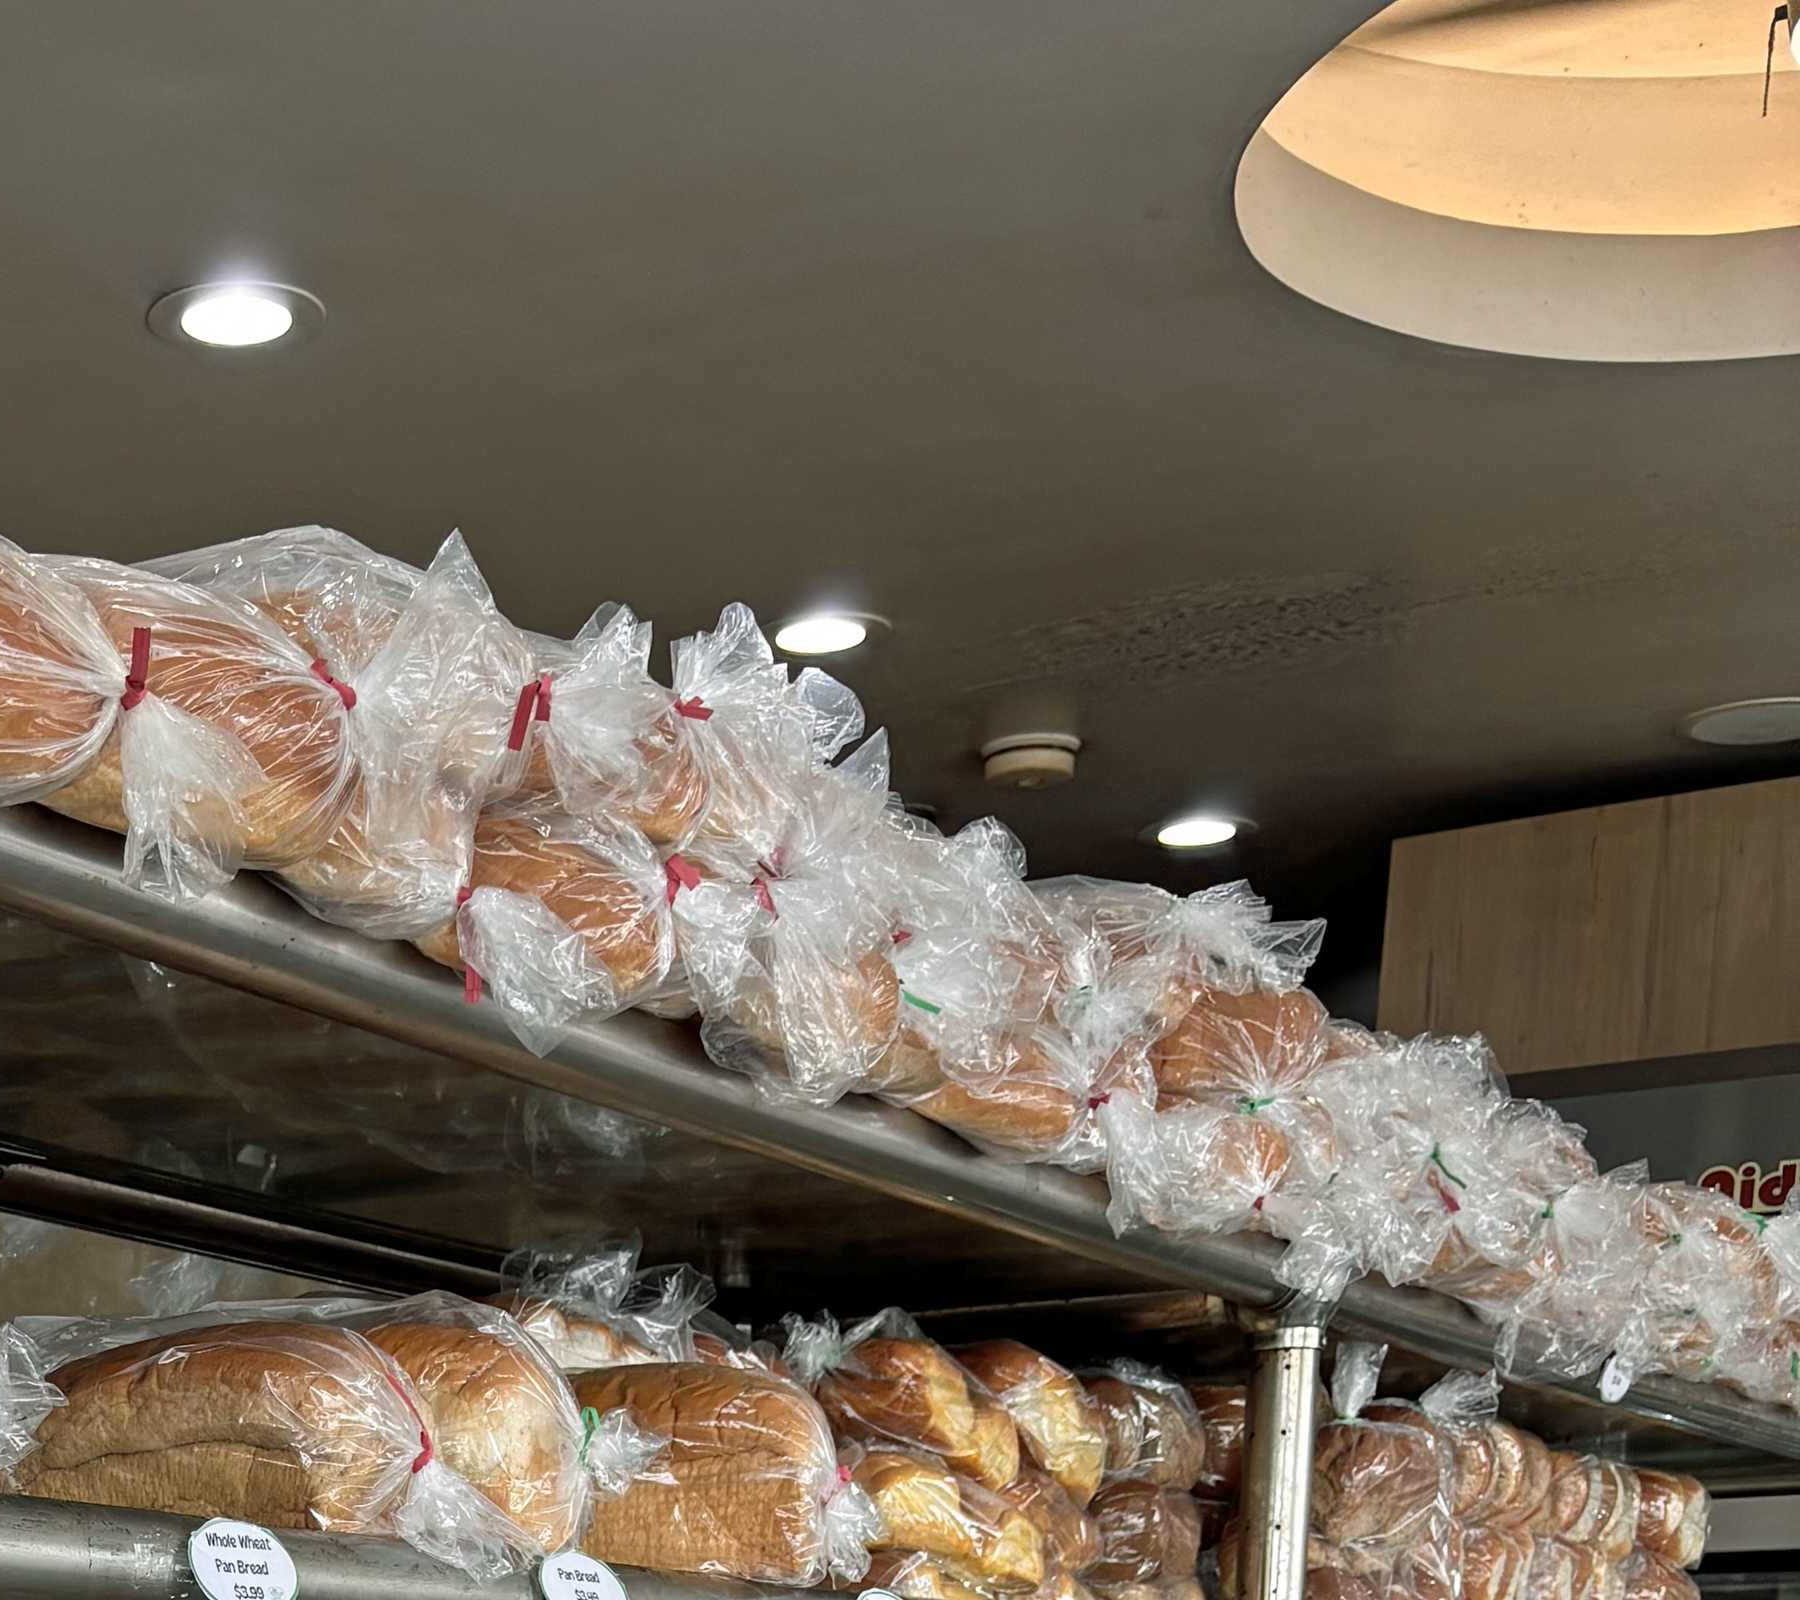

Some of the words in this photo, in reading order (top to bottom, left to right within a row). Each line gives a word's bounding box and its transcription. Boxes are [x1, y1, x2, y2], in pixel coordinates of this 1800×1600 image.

[205, 1532, 237, 1548] Whole
[238, 1534, 272, 1551] Wheat
[215, 1558, 236, 1573] Pan
[237, 1560, 269, 1575] Bread
[557, 1568, 575, 1581] Pan
[574, 1569, 600, 1583] Bread
[234, 1583, 265, 1600] $3.99
